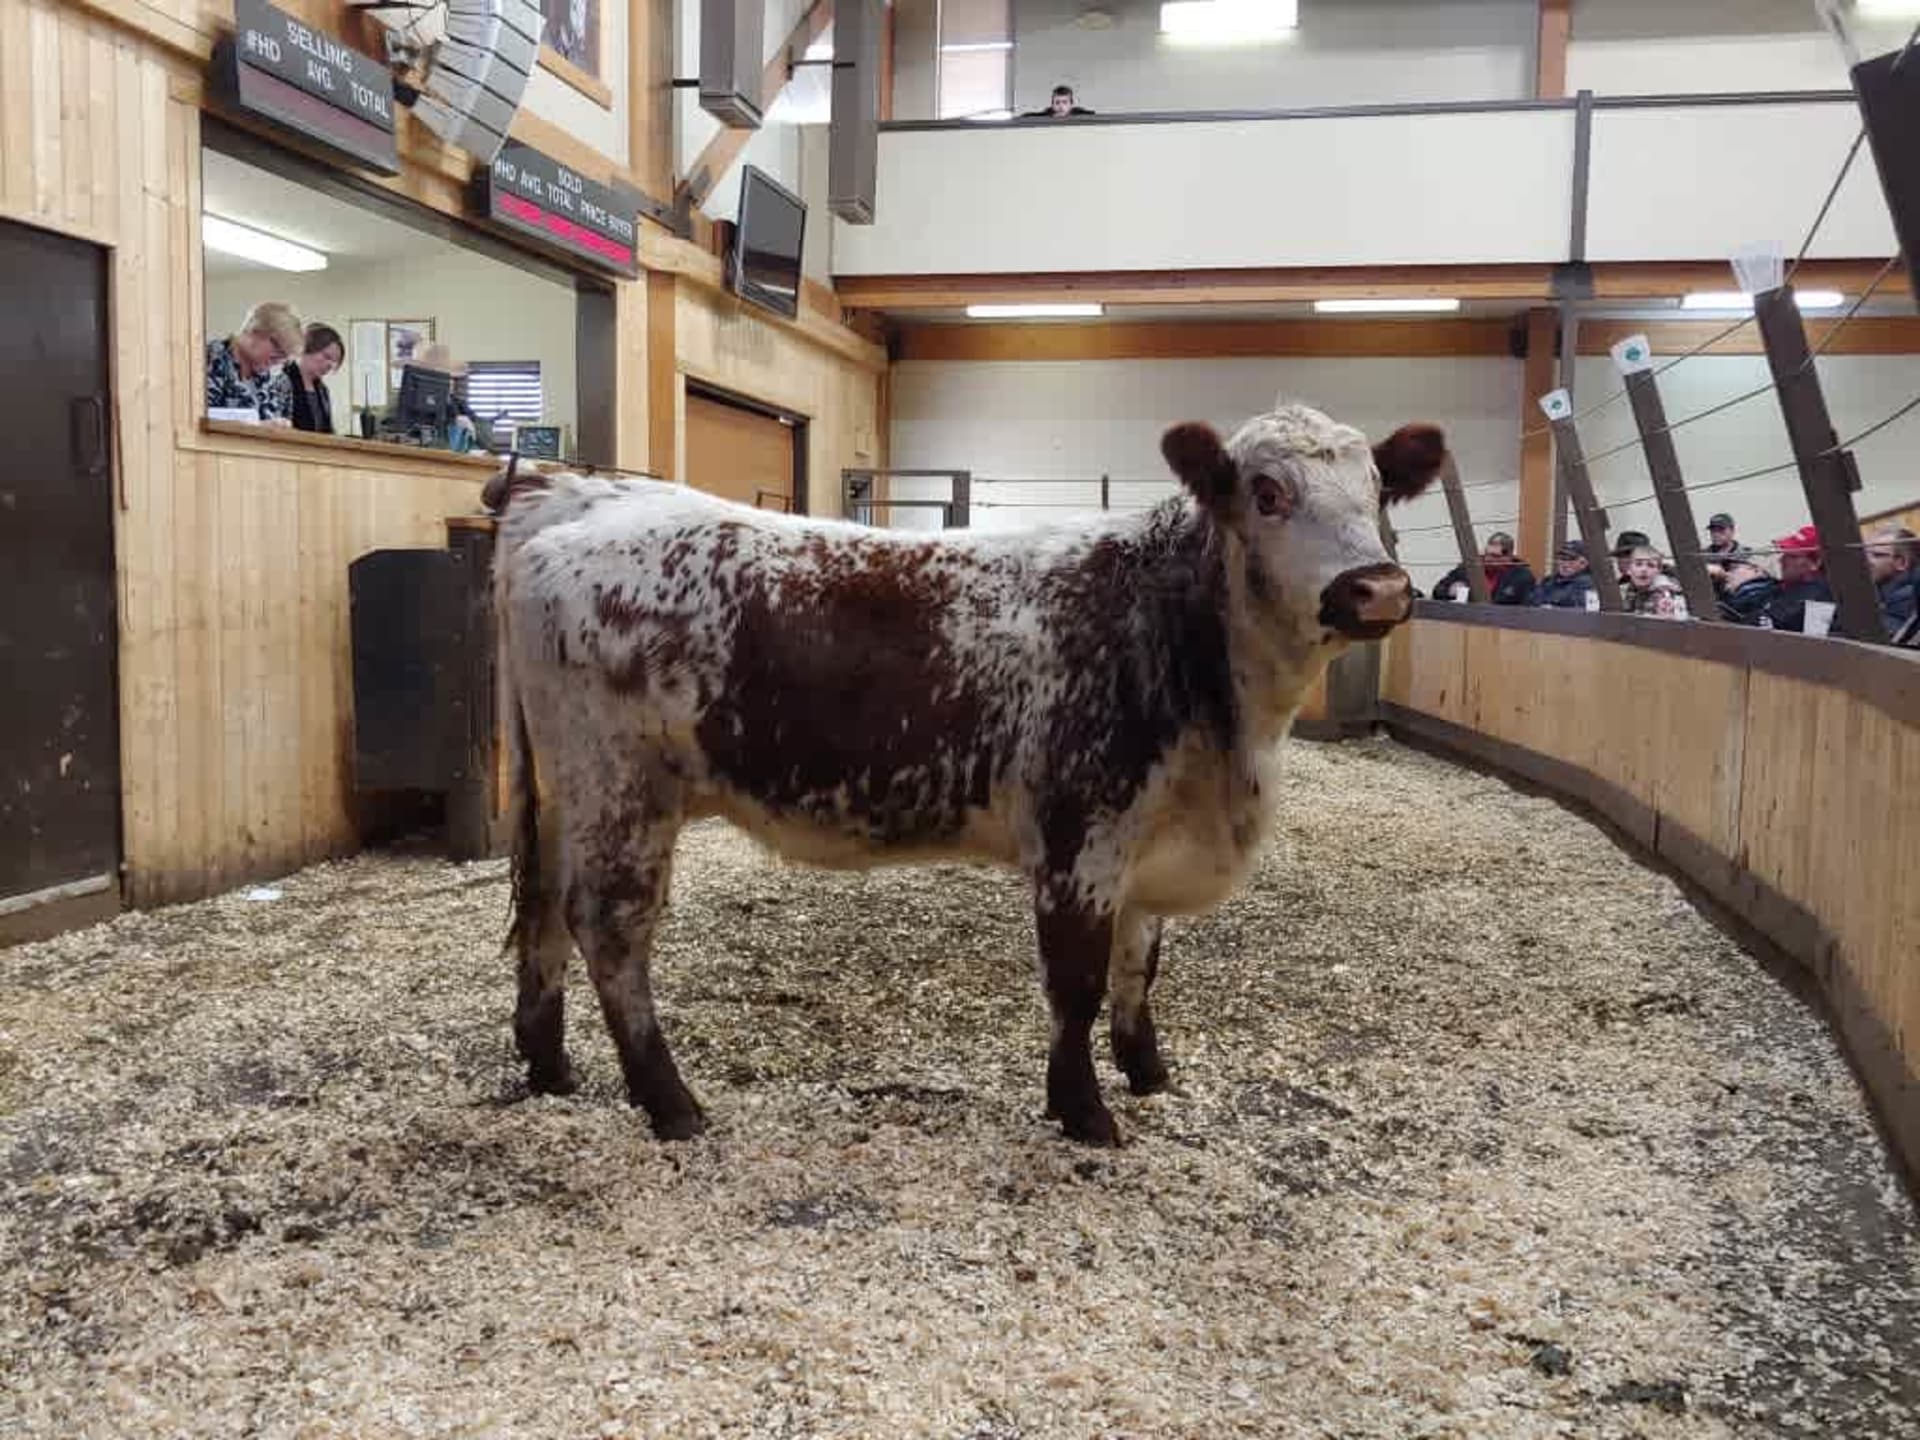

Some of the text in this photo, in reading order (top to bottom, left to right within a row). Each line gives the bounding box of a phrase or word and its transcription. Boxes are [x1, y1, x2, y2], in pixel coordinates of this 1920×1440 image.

[286, 20, 353, 74] SELLING
[246, 29, 281, 62] #HD
[350, 80, 390, 119] TOTAL
[546, 182, 574, 212] TOTAL
[557, 167, 583, 194] SOLD
